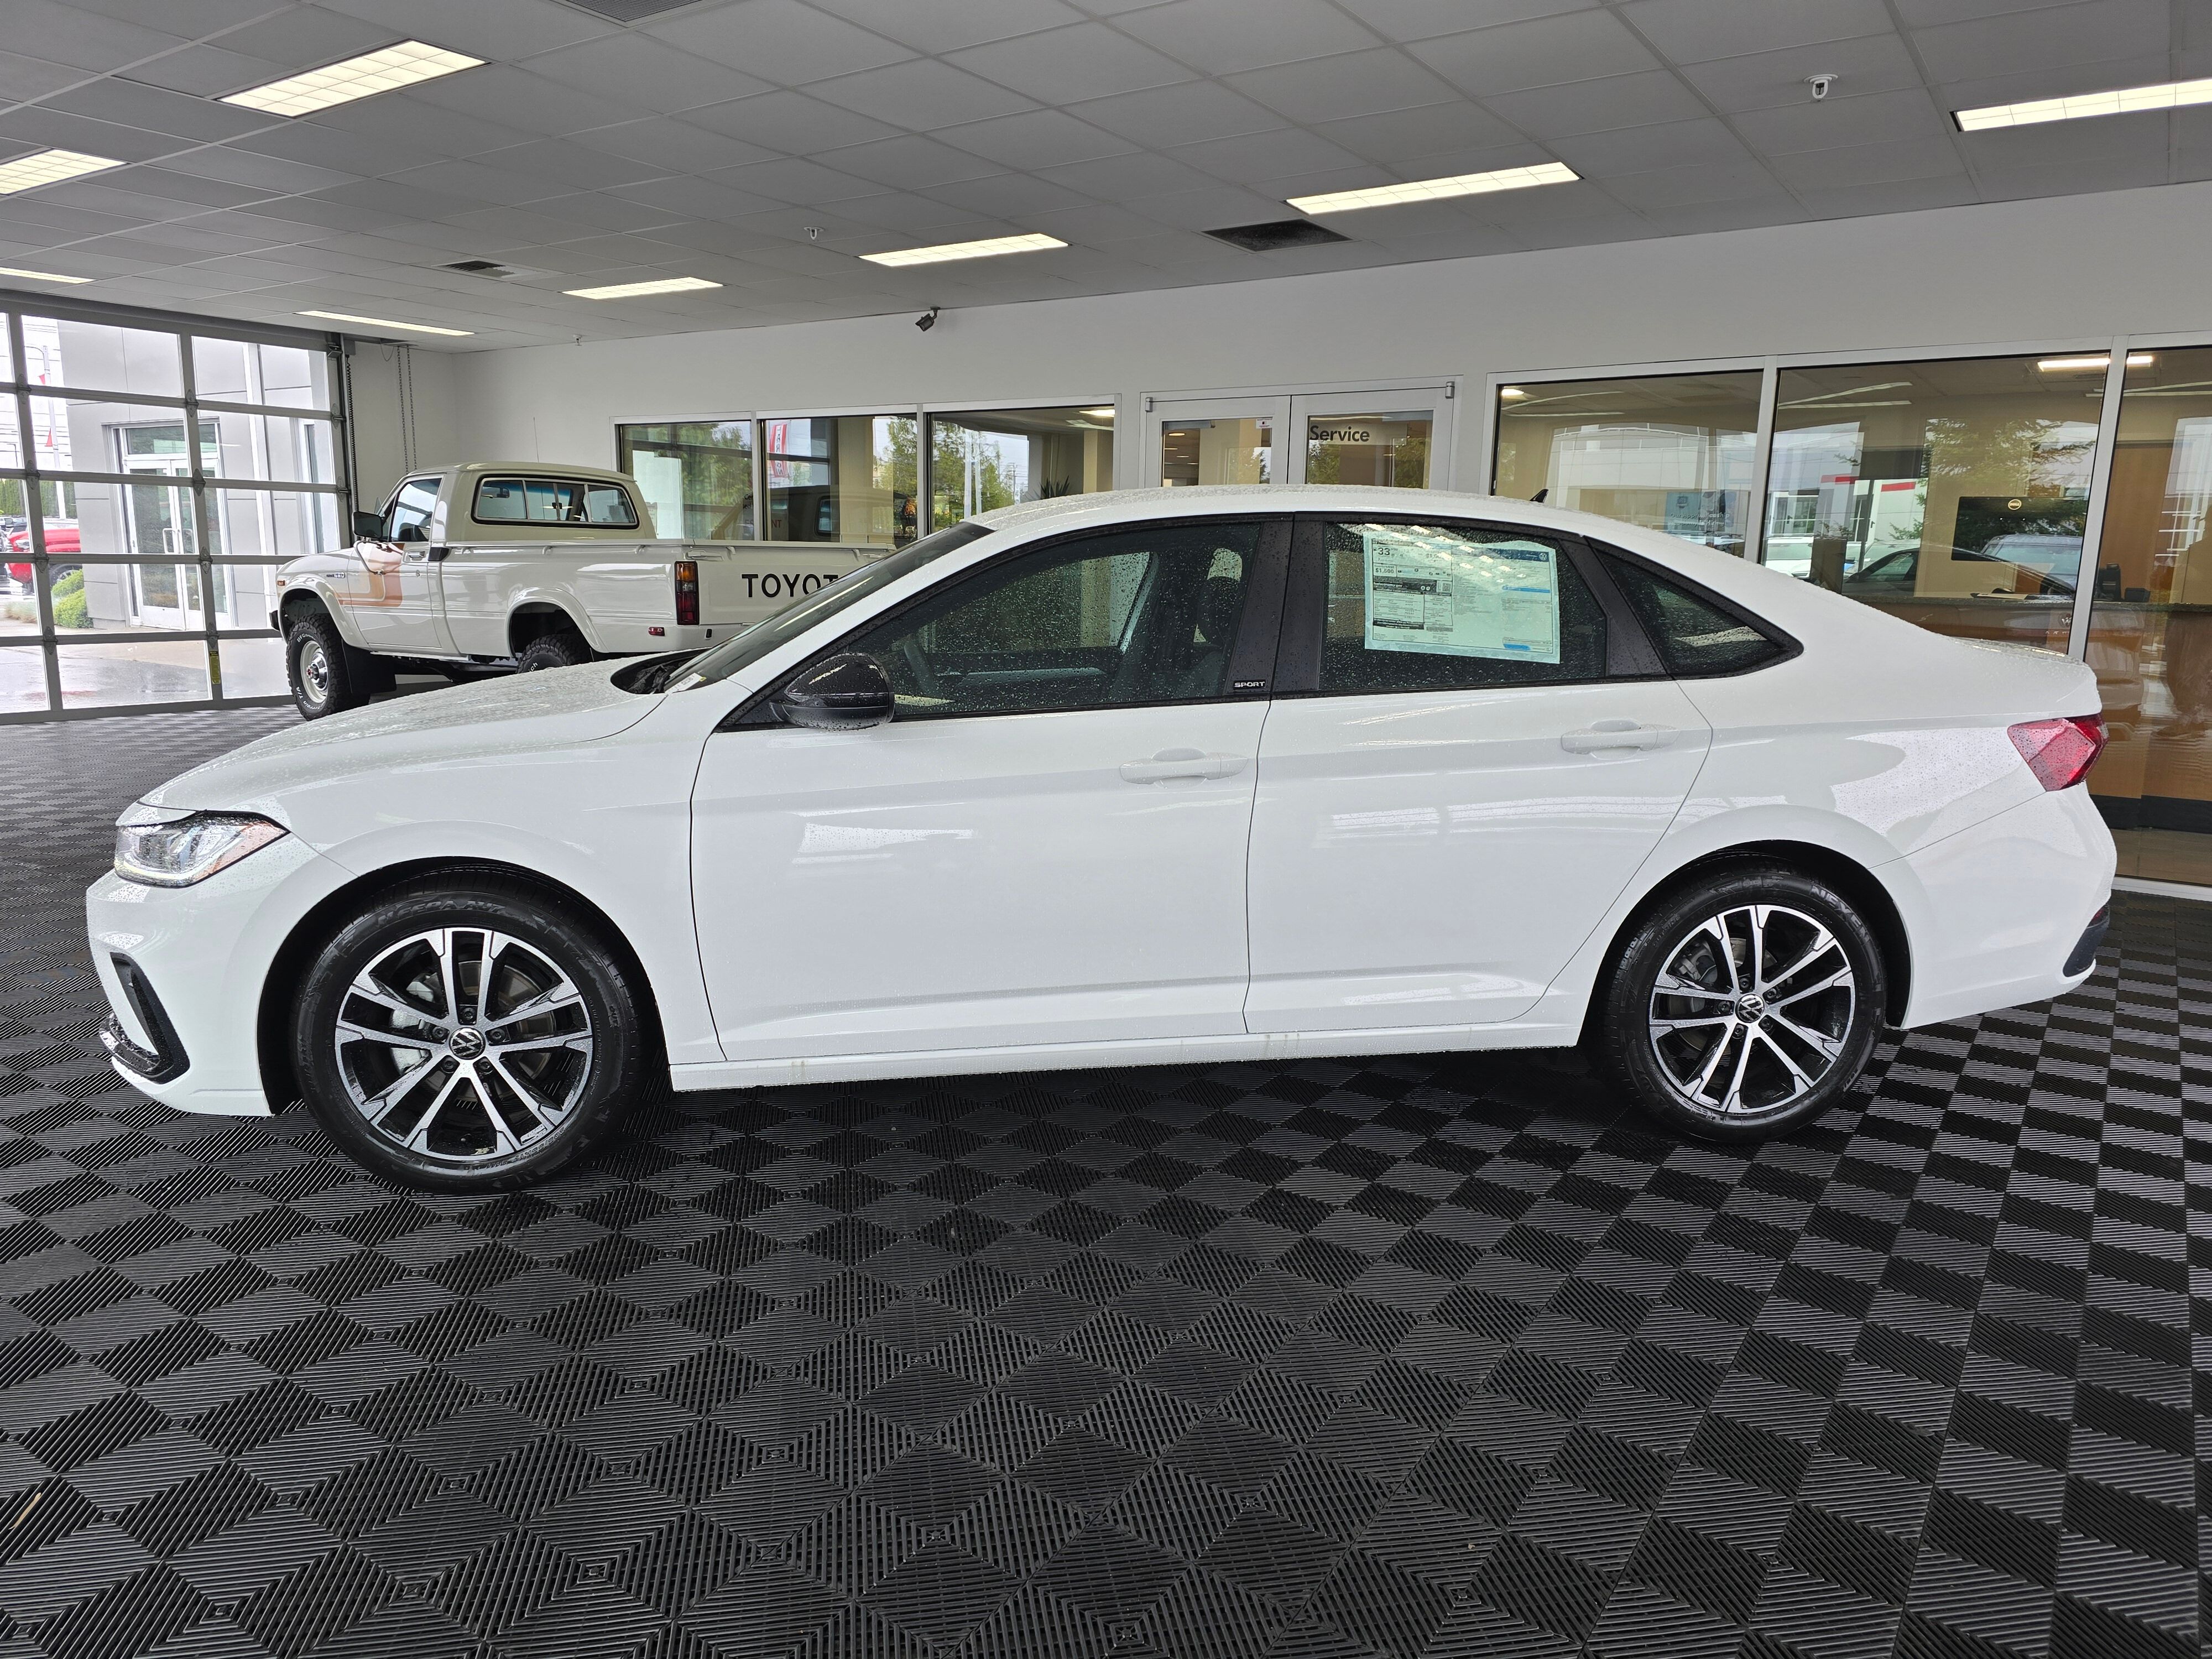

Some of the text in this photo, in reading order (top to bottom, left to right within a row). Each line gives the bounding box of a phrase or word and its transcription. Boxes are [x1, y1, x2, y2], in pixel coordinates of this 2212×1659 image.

[1310, 425, 1370, 442] Service
[1378, 547, 1391, 555] 33
[741, 573, 838, 598] TOYOT
[1809, 885, 1871, 944] NEXEN
